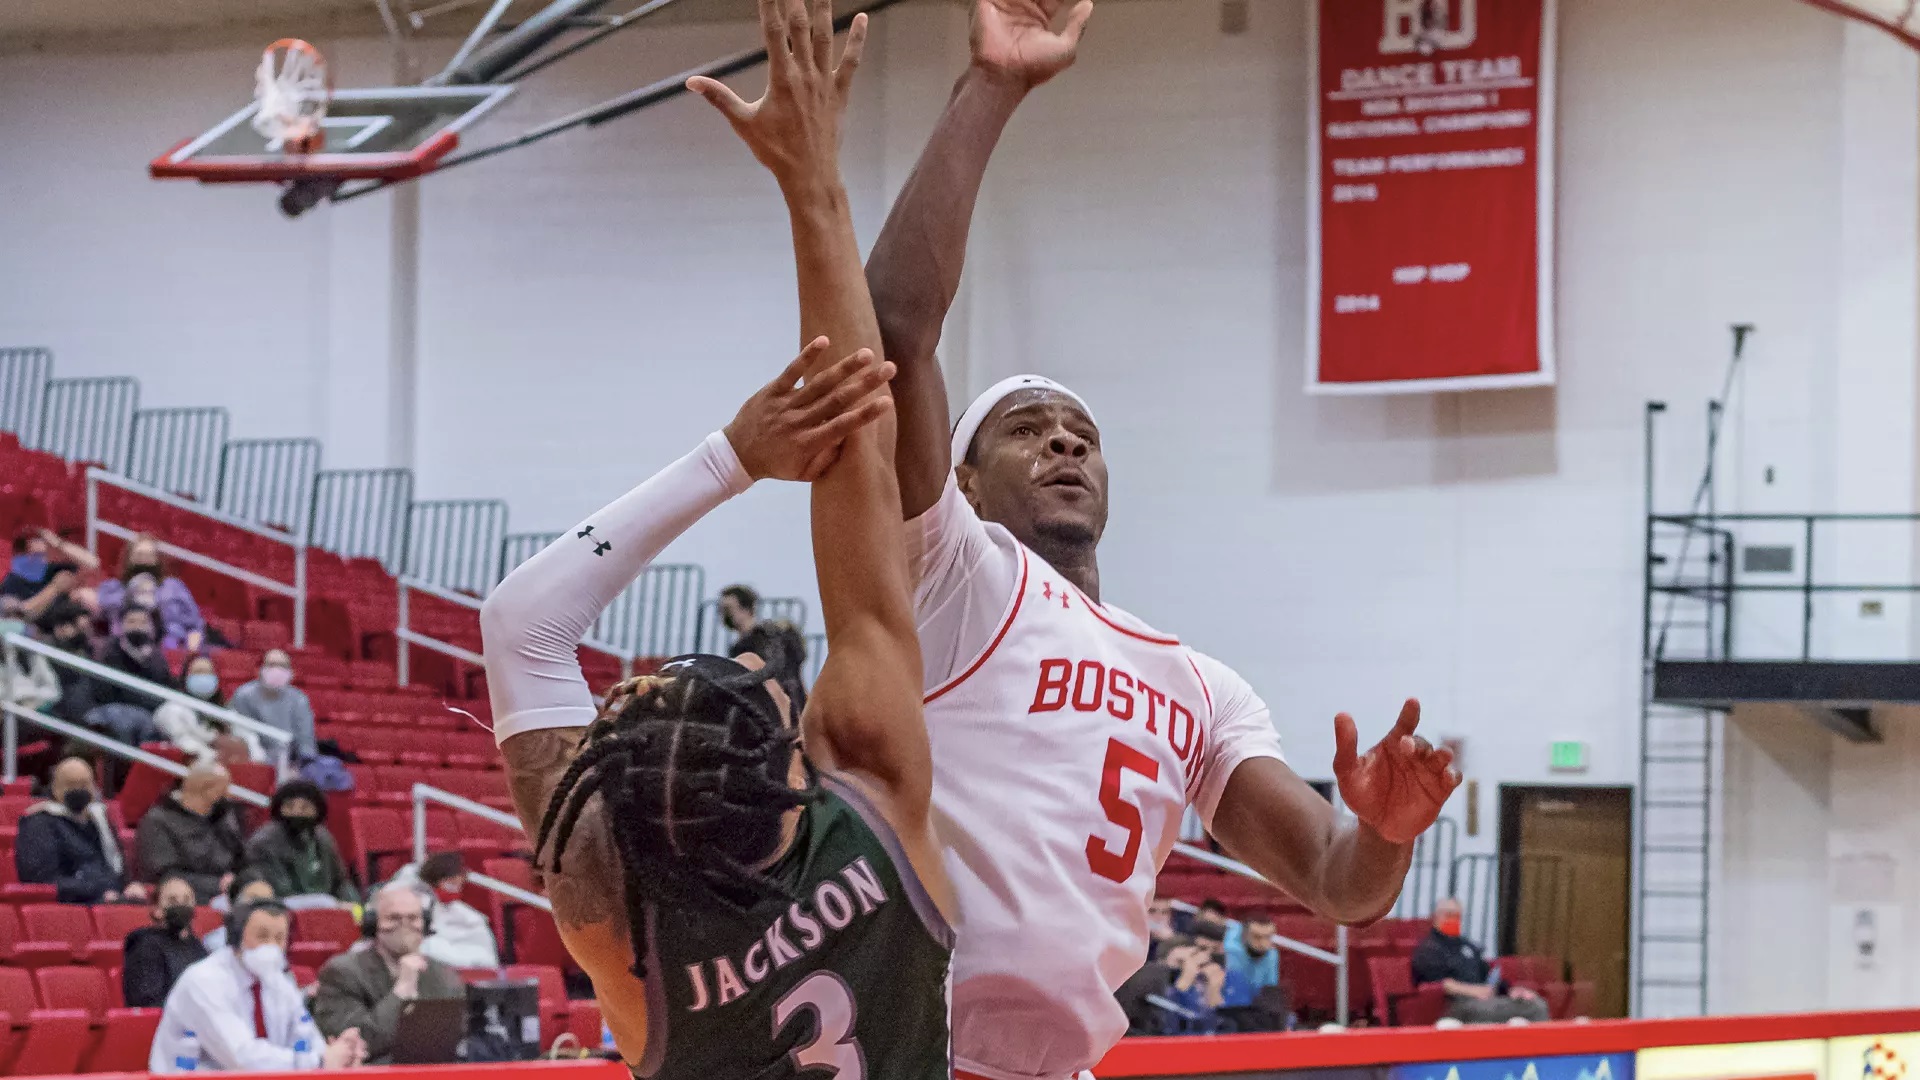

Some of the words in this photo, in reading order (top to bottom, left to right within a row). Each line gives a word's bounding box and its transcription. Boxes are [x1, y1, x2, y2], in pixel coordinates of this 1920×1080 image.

[1340, 62, 1434, 91] DANCE
[1441, 56, 1522, 83] TEAM
[1332, 156, 1385, 175] TEAM
[1388, 147, 1525, 172] PERFORMANCE
[1085, 737, 1159, 883] 5
[685, 856, 889, 1011] JACKSON
[772, 969, 868, 1080] 3
